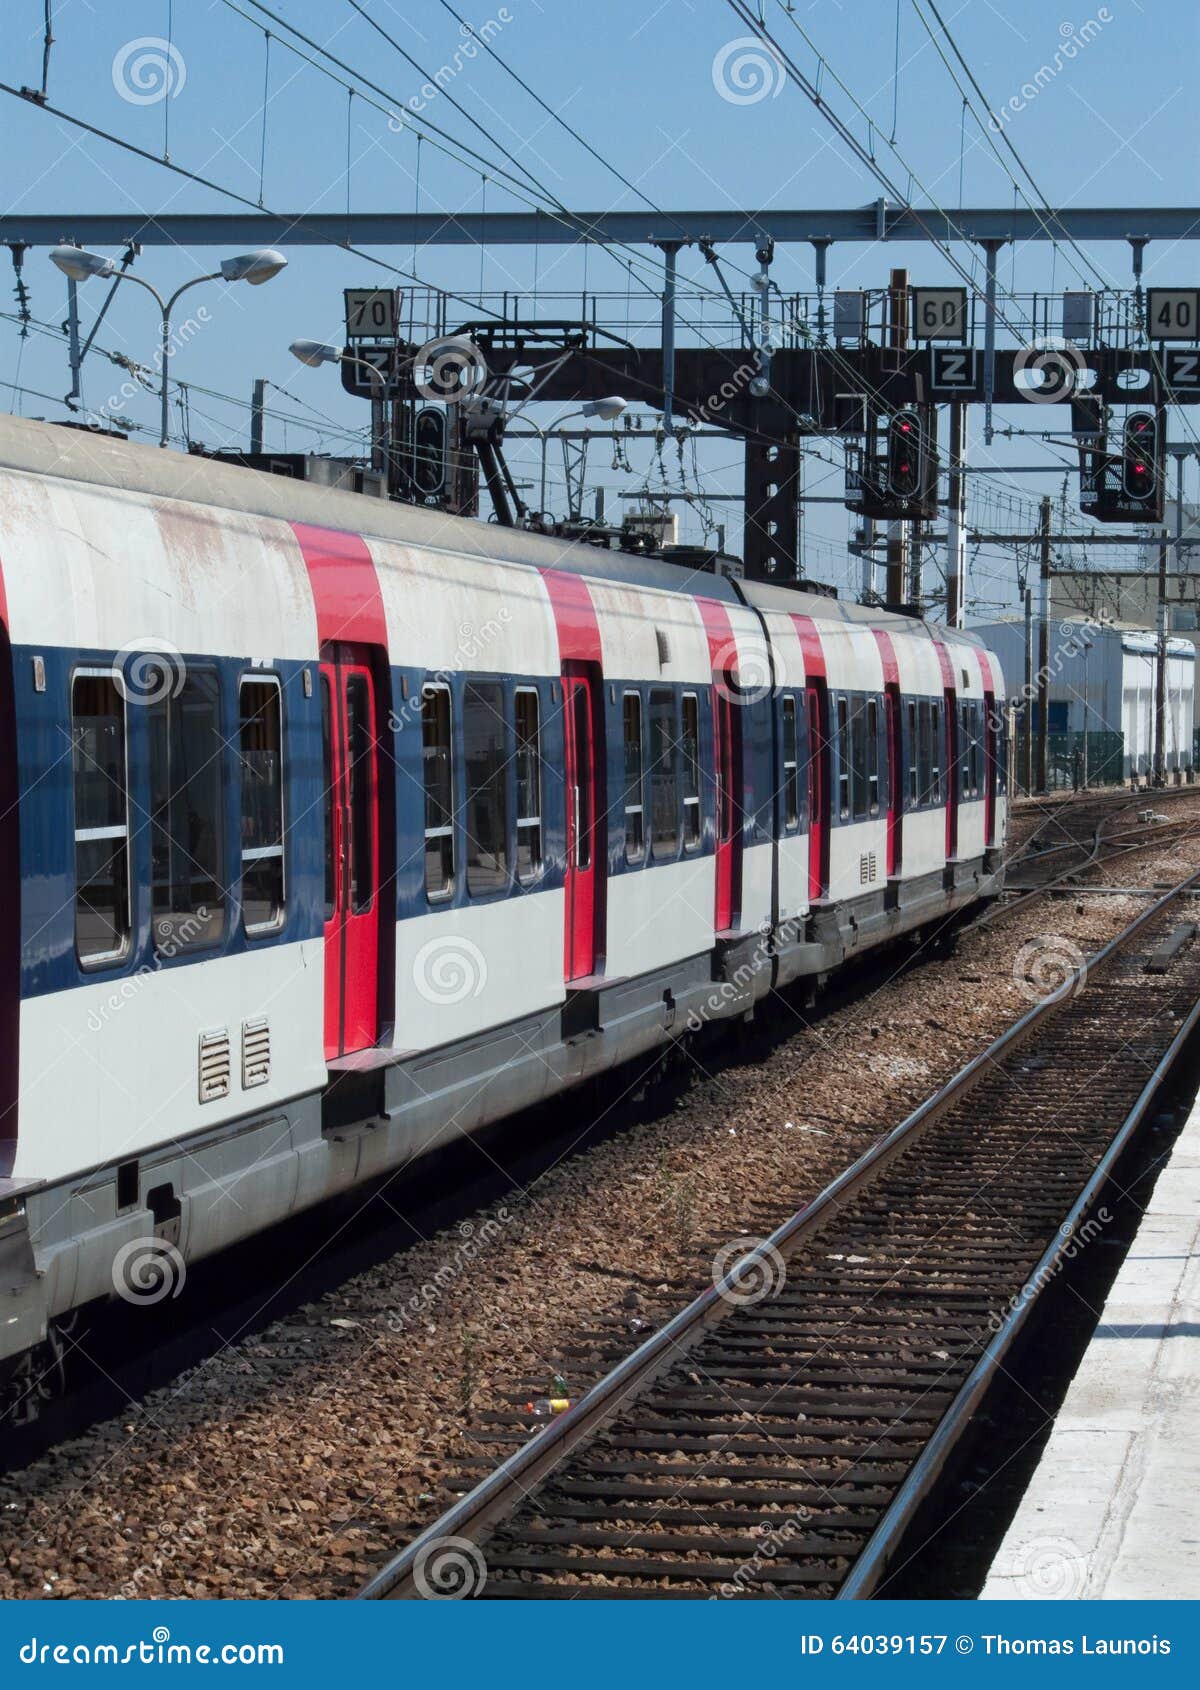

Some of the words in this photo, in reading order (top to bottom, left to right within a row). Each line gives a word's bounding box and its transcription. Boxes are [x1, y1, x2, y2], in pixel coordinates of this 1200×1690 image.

[354, 301, 385, 326] 70
[924, 301, 956, 327] 60
[1158, 301, 1190, 328] 40
[941, 354, 966, 381] Z
[1173, 356, 1199, 382] Z
